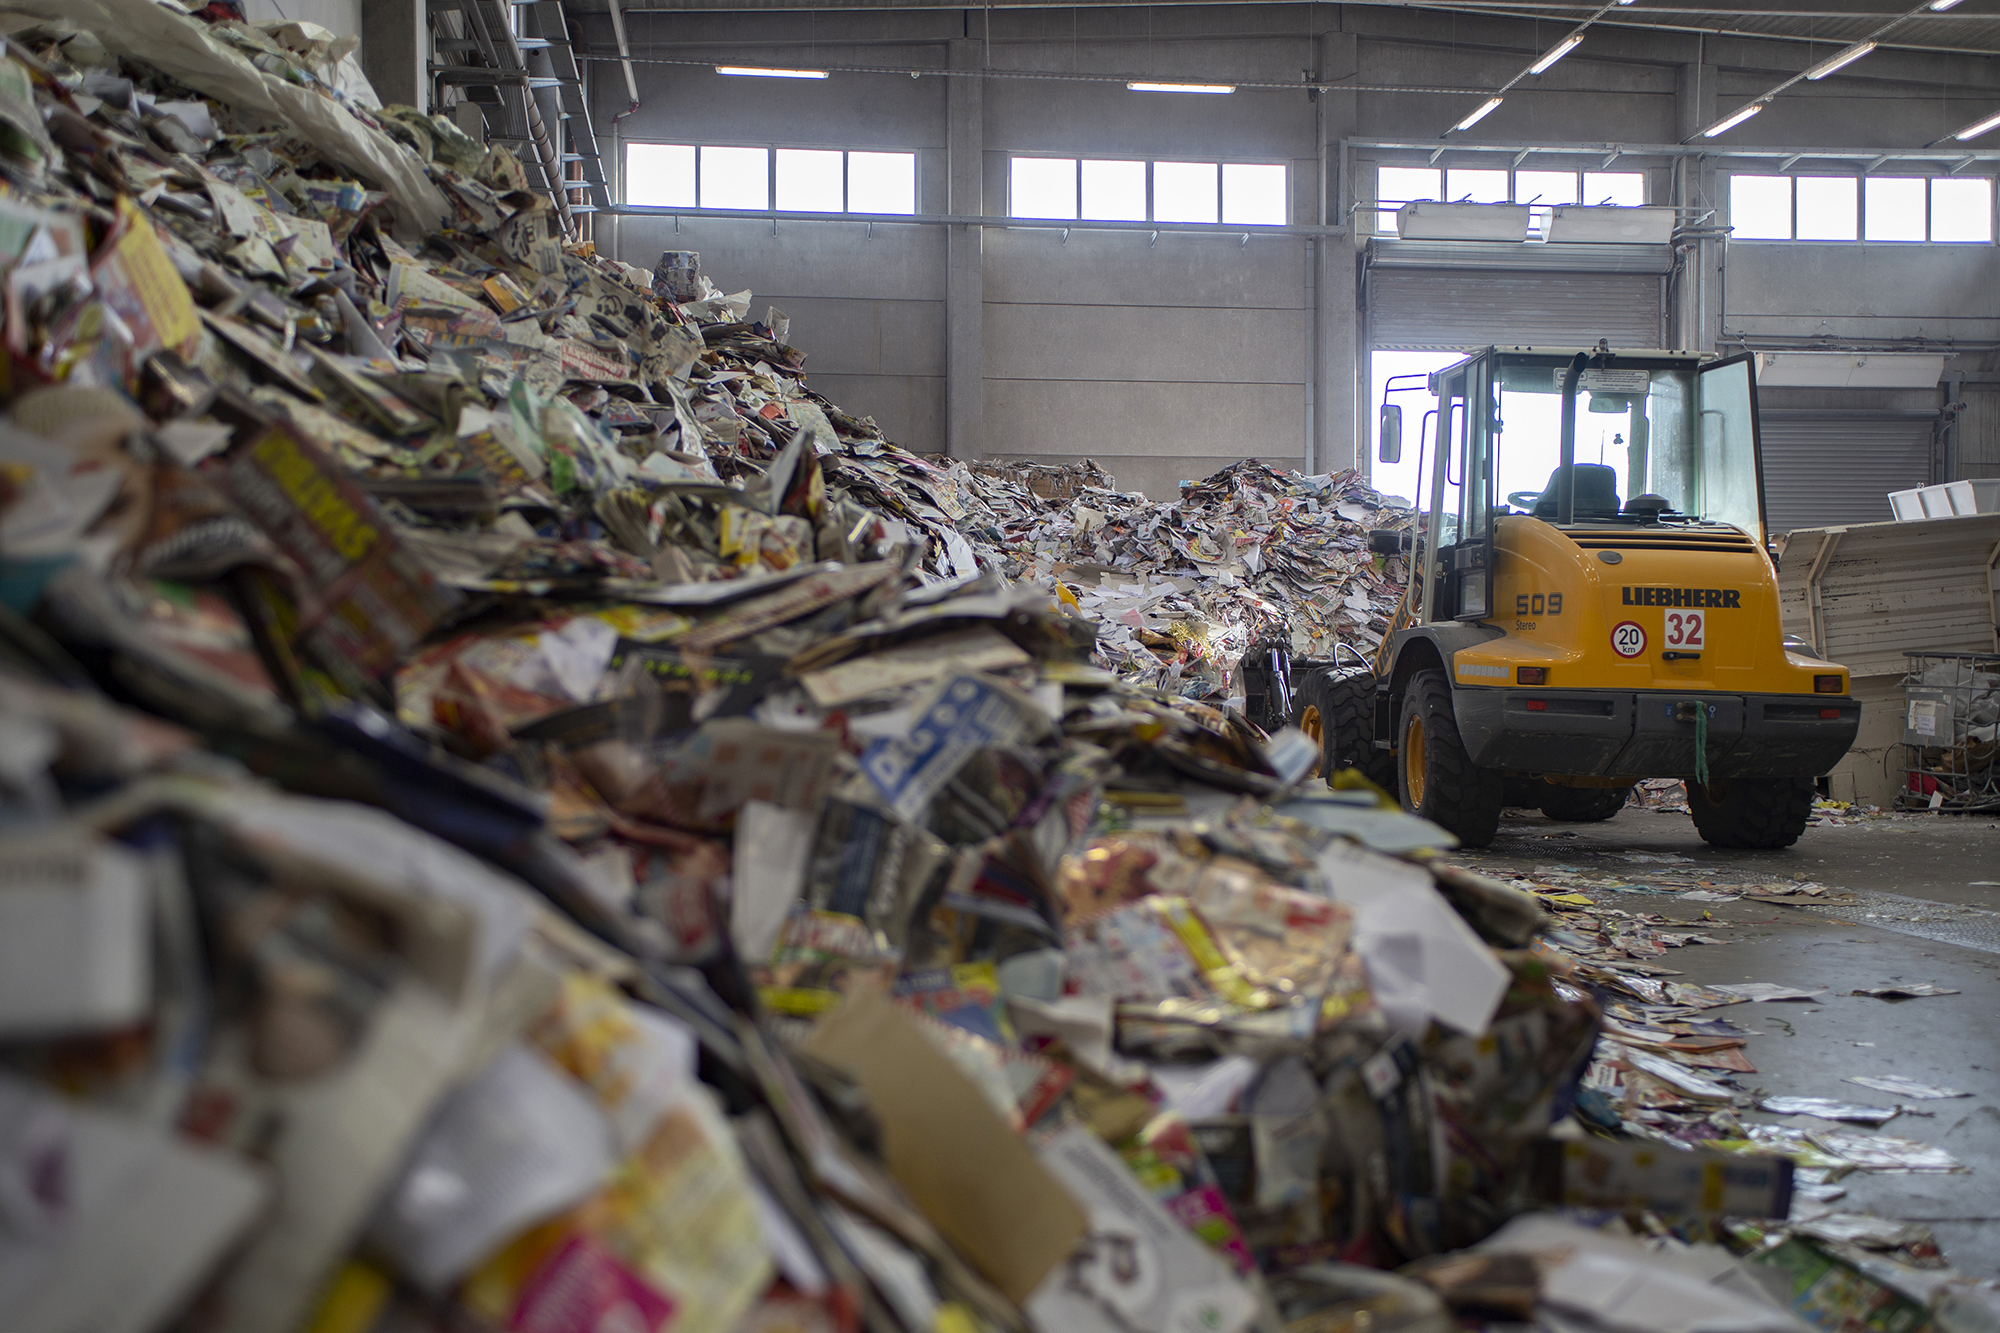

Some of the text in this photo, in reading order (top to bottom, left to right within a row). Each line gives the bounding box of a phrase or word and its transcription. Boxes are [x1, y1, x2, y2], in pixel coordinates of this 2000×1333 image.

[1516, 592, 1562, 616] 509
[1622, 587, 1741, 608] LIEBHERR
[1516, 620, 1536, 630] Stereo
[1667, 613, 1702, 645] 32
[1618, 628, 1639, 645] 20
[1623, 645, 1636, 653] km
